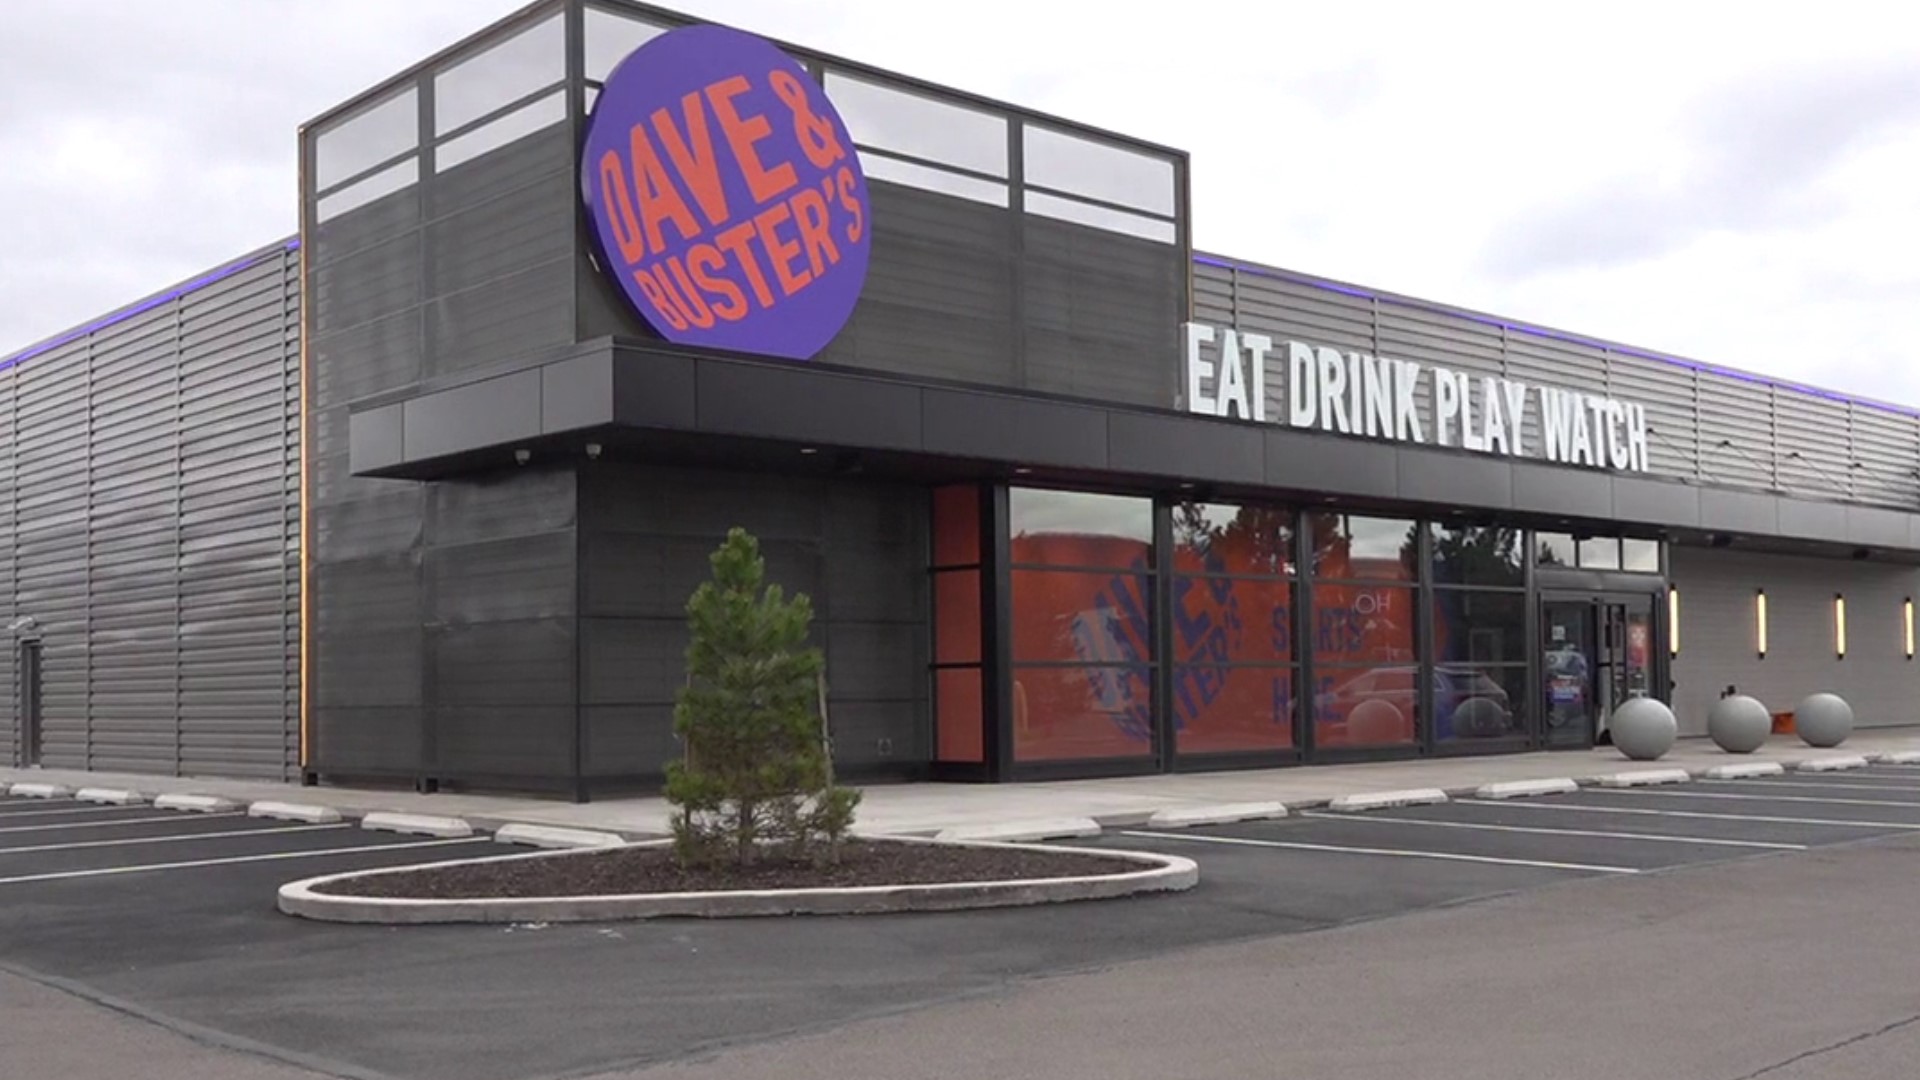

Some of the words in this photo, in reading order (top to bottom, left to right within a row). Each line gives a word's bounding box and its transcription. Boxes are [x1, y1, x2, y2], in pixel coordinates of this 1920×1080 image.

[599, 75, 798, 265] DAVE
[769, 70, 845, 169] &
[633, 166, 863, 330] BUSTER'S
[1182, 322, 1272, 422] EAT
[1285, 341, 1423, 442] DRINK
[1429, 367, 1526, 457] PLAY
[1534, 386, 1649, 472] WATCH
[1271, 606, 1363, 653] SRTS
